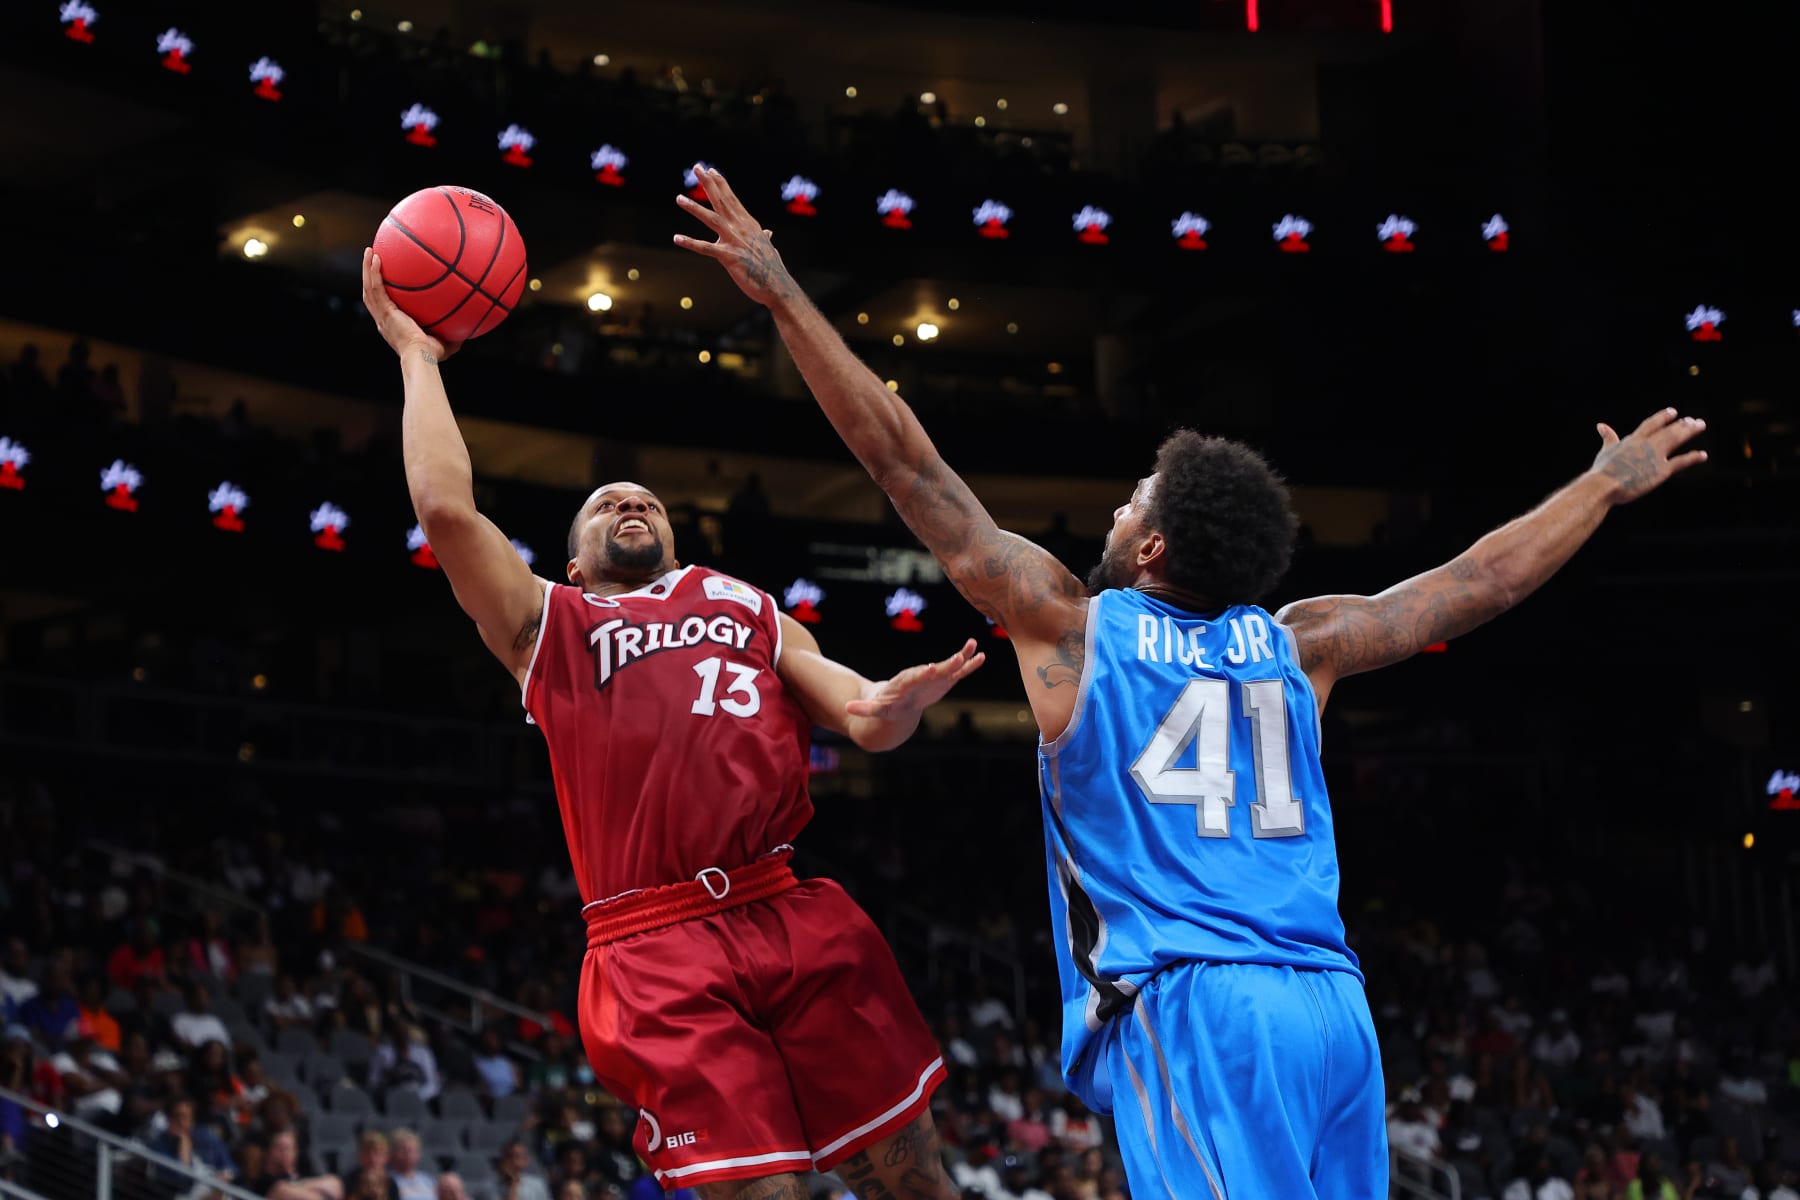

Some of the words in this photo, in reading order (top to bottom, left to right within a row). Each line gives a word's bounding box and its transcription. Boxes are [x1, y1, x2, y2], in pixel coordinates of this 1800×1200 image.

[588, 611, 753, 688] TRILOGY
[1137, 613, 1215, 669] RICE
[1227, 614, 1275, 664] JR
[690, 656, 762, 718] 13
[1128, 678, 1305, 839] 41
